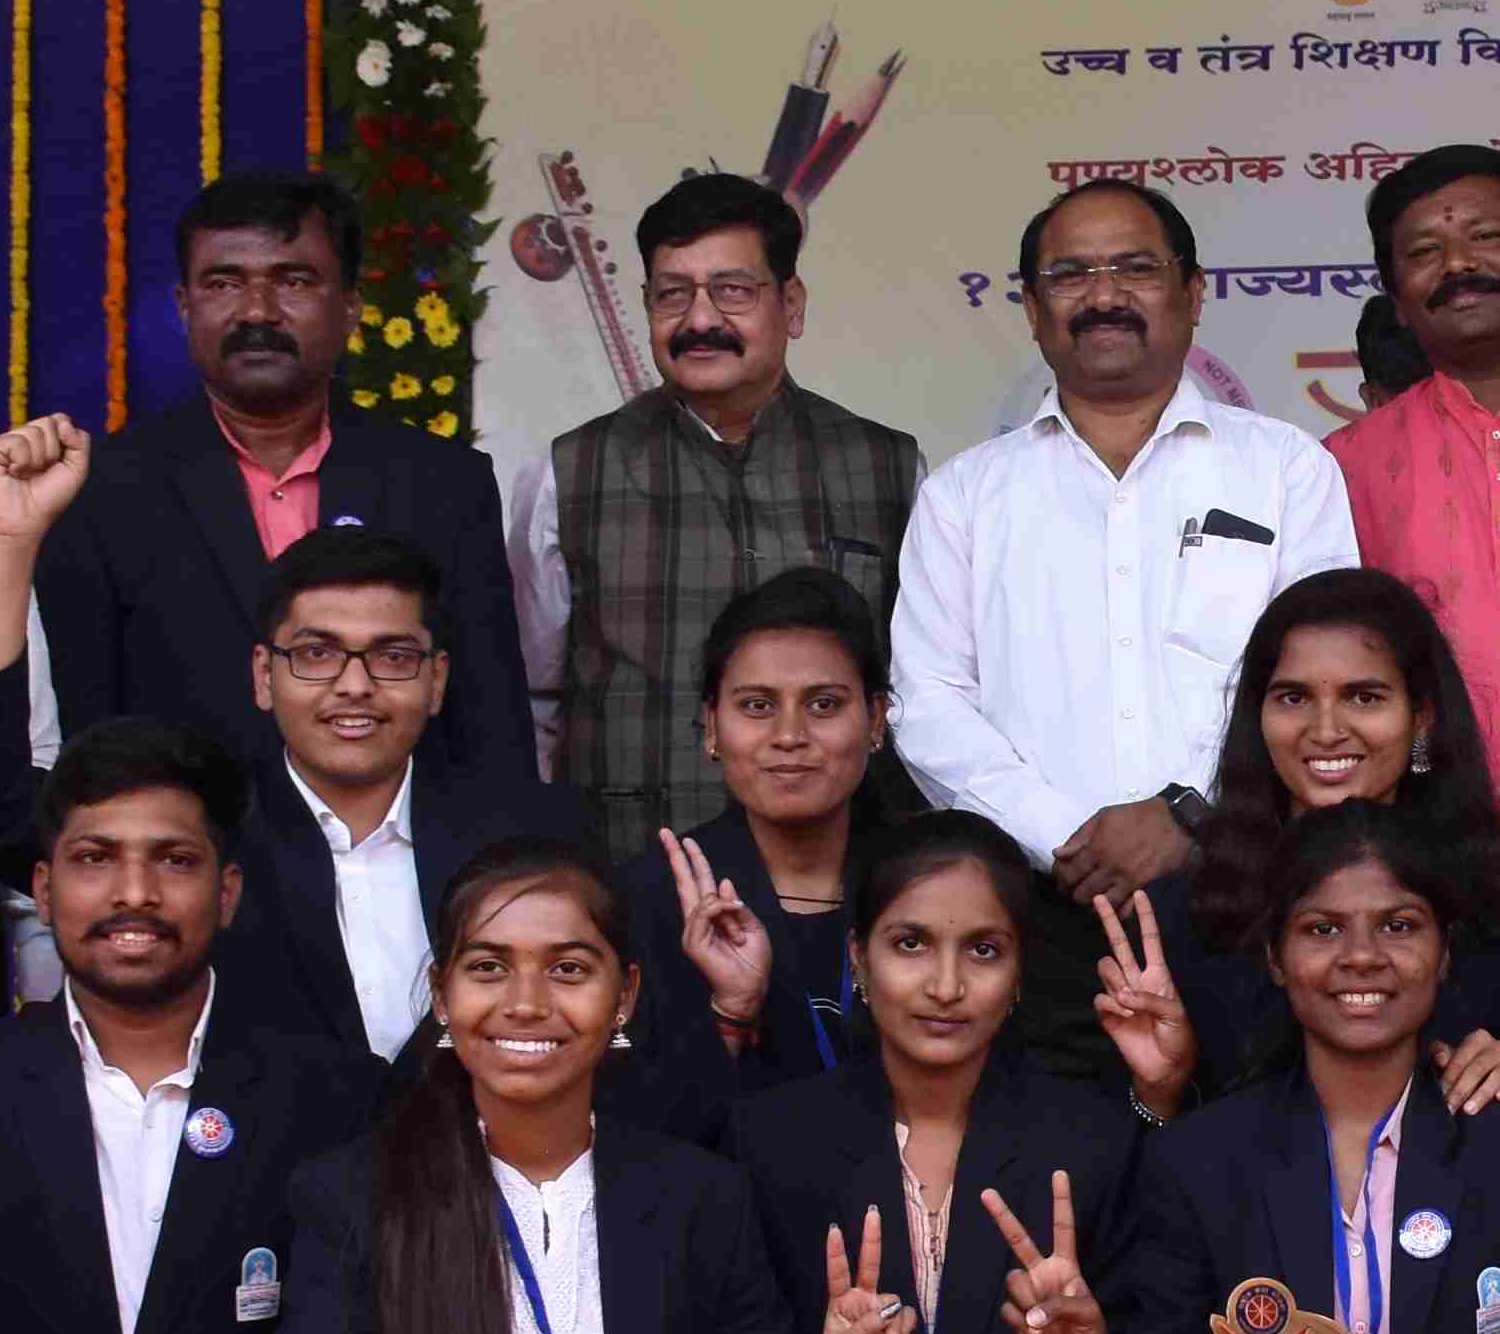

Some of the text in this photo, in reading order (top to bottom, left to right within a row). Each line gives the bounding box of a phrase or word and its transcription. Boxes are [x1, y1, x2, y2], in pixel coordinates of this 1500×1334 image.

[1041, 49, 1129, 75] उच्च
[1146, 47, 1181, 74] व
[1198, 34, 1274, 74] तंत्र
[1290, 32, 1440, 70] शिक्षण
[1203, 359, 1231, 386] NOT
